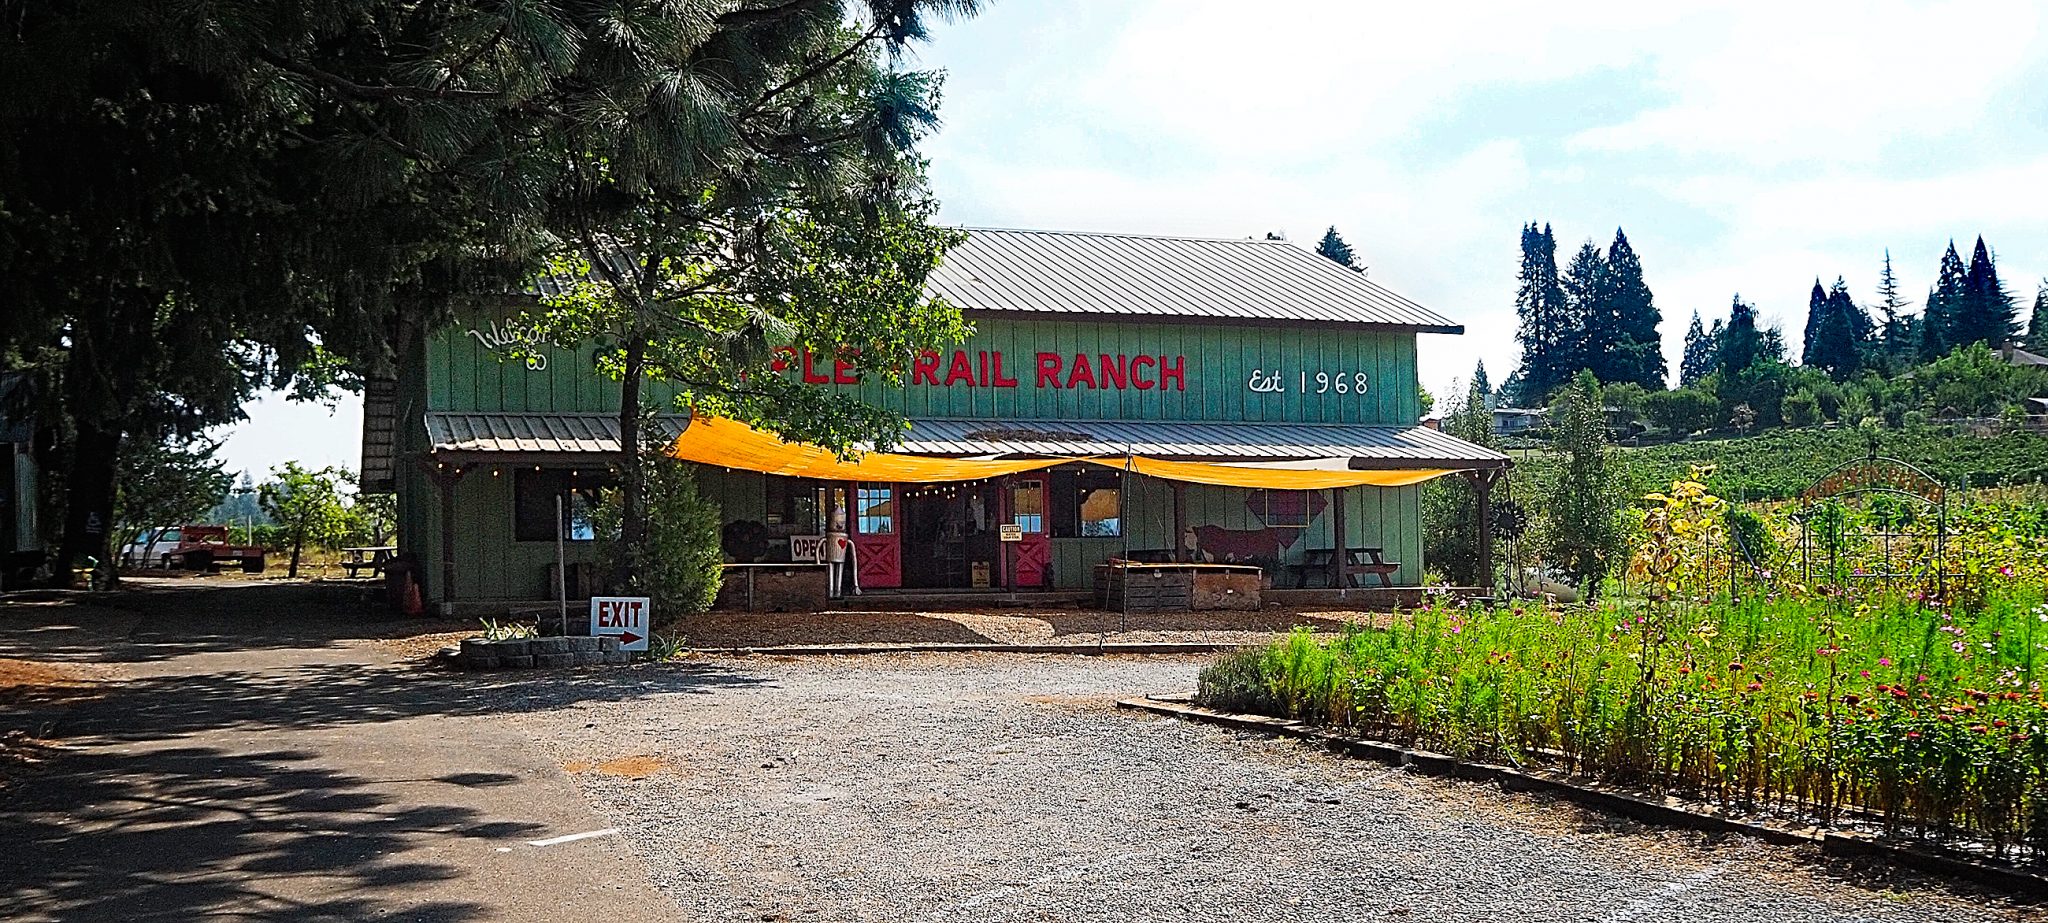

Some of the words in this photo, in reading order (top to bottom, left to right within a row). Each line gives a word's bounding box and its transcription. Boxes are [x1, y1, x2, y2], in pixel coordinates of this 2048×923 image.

[738, 344, 862, 384] PLE
[890, 349, 1018, 388] RAIL
[1036, 351, 1185, 391] RANCH
[1248, 369, 1285, 393] Est
[1300, 371, 1368, 394] 1968
[598, 601, 643, 628] EXIT
